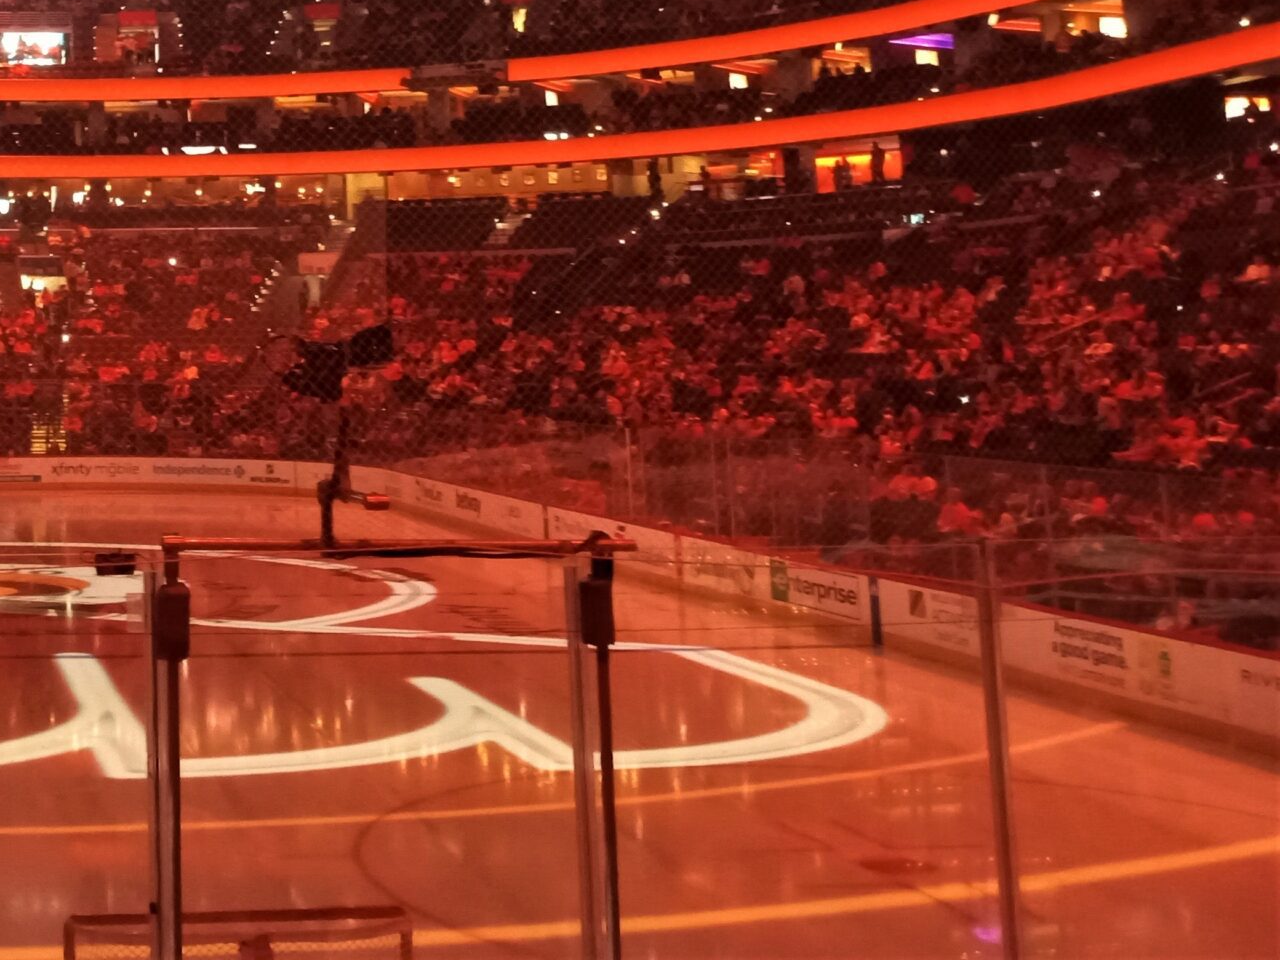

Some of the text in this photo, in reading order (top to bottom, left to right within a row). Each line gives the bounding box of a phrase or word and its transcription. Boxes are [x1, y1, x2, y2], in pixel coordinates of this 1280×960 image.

[51, 462, 93, 476] xfinity
[152, 463, 233, 476] Independence
[773, 572, 857, 606] enterprise
